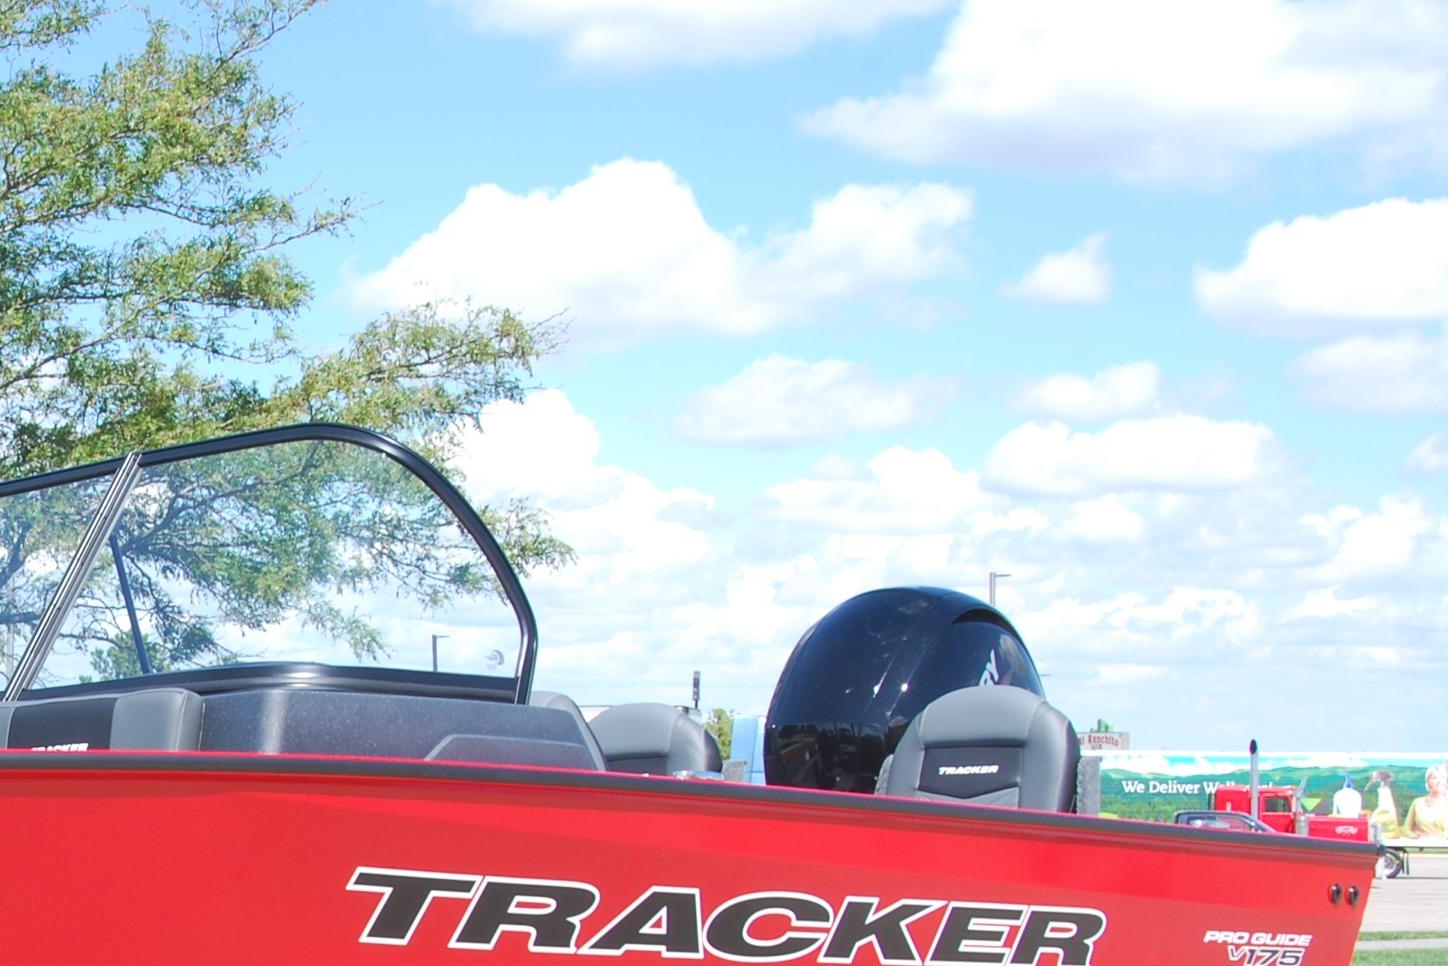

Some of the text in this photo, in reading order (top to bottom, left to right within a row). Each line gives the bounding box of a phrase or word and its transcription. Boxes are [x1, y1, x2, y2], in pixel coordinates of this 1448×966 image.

[938, 764, 1000, 776] TRACKER
[1122, 780, 1145, 794] We
[1149, 780, 1201, 794] Deliver
[1203, 930, 1312, 946] PRO GUIDE
